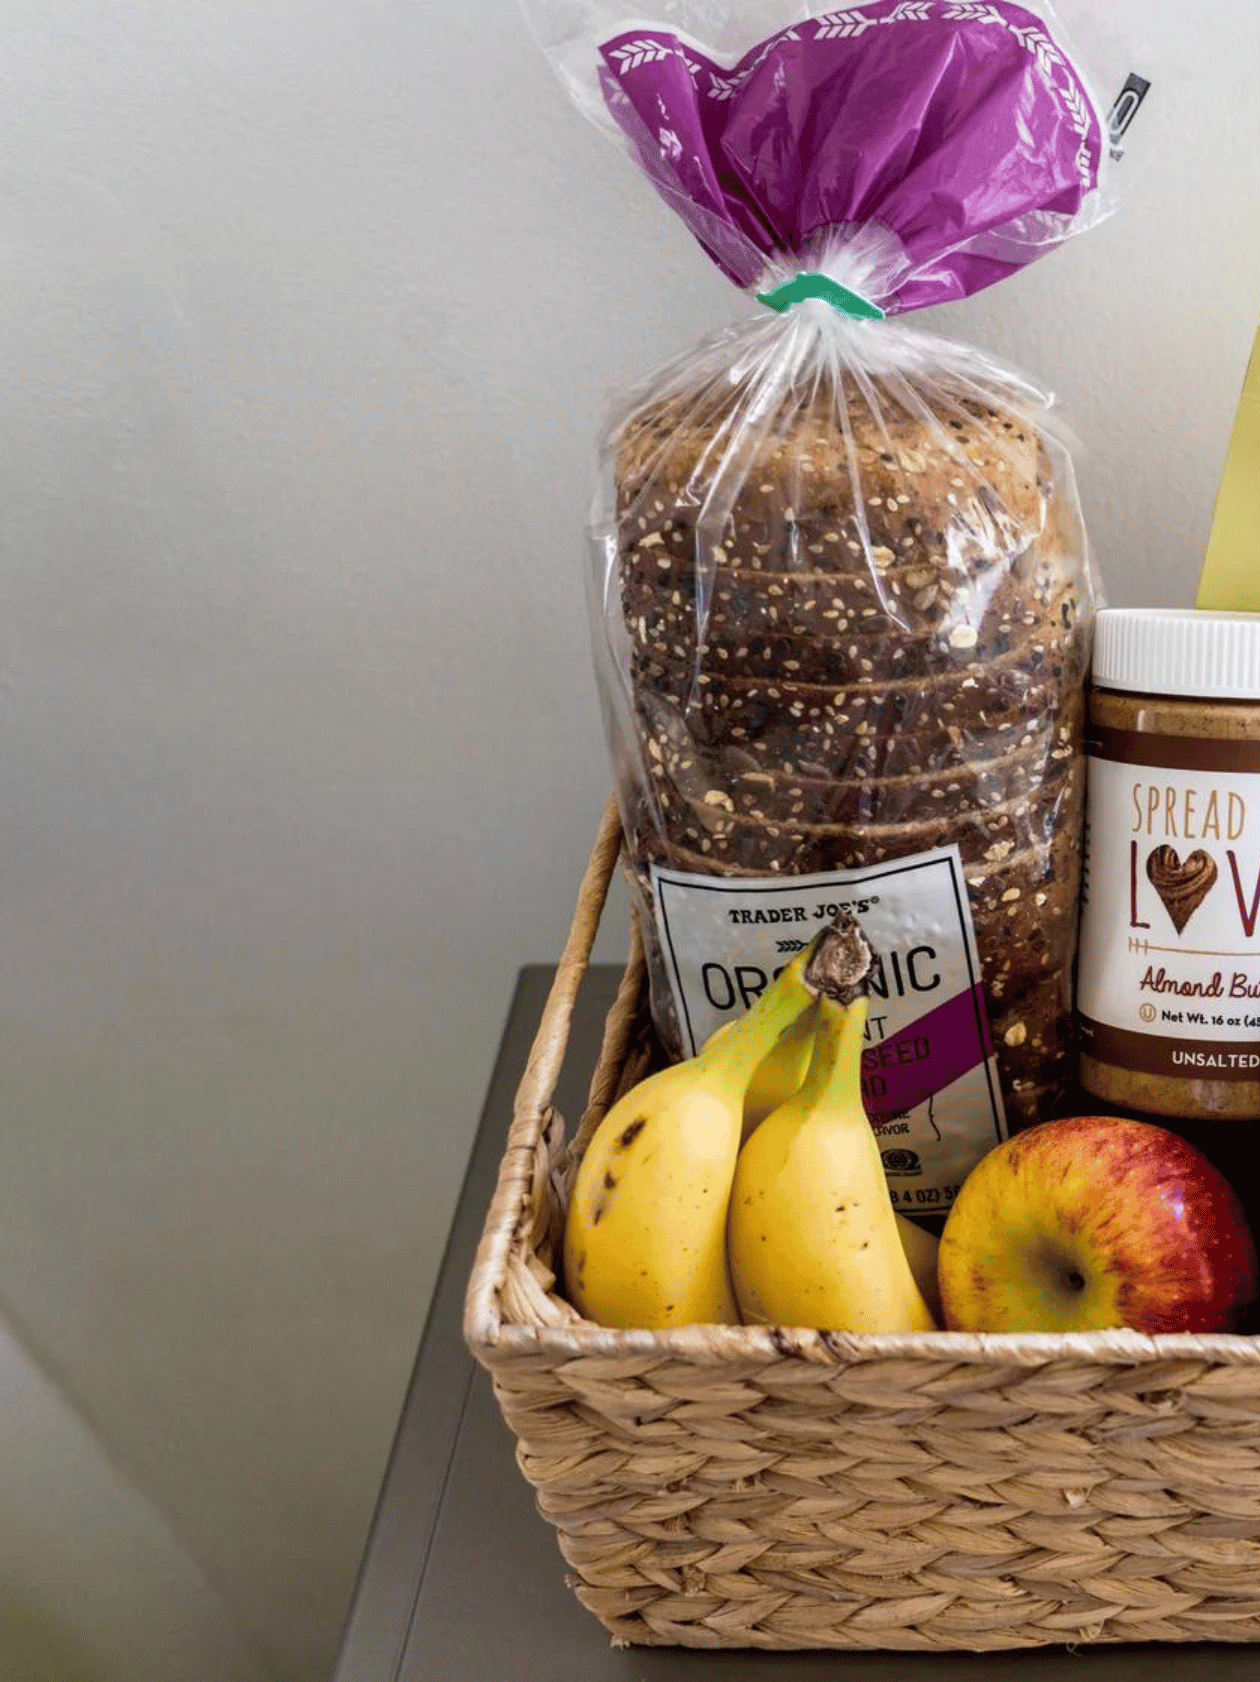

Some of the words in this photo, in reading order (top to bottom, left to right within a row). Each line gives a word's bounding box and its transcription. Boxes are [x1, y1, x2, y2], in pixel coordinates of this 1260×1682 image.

[1131, 783, 1246, 841] SPREAD
[728, 907, 808, 924] TRADER
[701, 946, 941, 1010] ORNIC
[1140, 965, 1225, 998] Almond
[1161, 1010, 1183, 1023] Net
[1187, 1012, 1208, 1025] Wt.
[1212, 1016, 1224, 1026] 16
[1227, 1018, 1241, 1026] oz
[1172, 1051, 1260, 1068] UNSALTED
